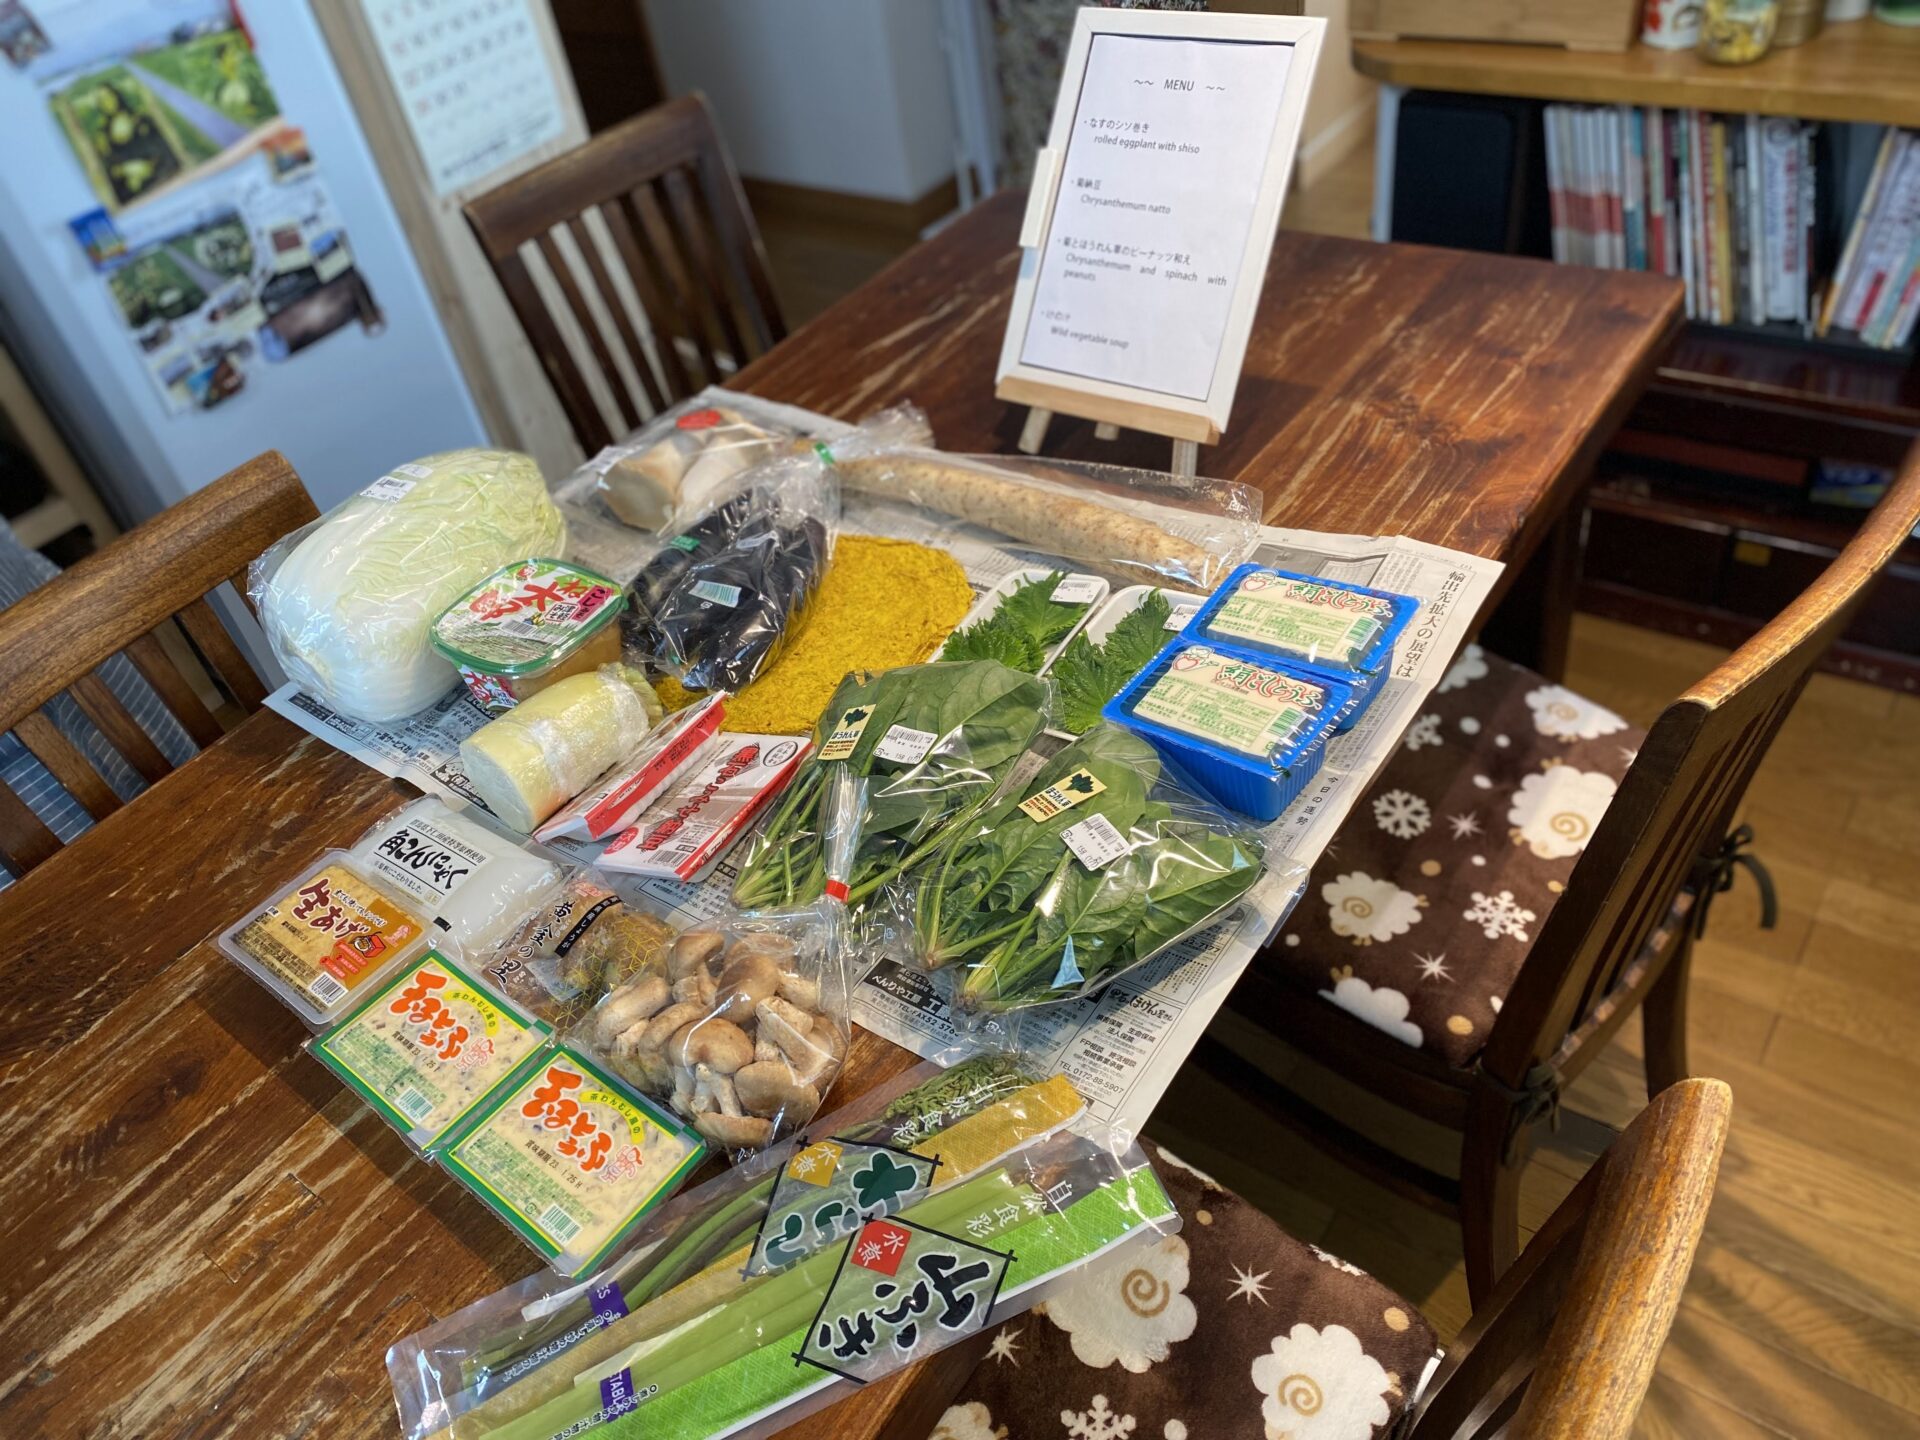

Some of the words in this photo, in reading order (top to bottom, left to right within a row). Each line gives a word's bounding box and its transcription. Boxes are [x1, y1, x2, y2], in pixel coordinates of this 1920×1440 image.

[1164, 78, 1195, 92] MENU
[1094, 134, 1118, 146] rolled
[1119, 137, 1157, 150] eggplant
[1158, 141, 1177, 152] with
[1178, 144, 1200, 154] shiso
[1080, 194, 1146, 212] Chrysanthemum
[1148, 203, 1171, 215] natto
[1063, 268, 1097, 282] peanuts
[1065, 252, 1131, 271] Chrysanthemum
[1139, 265, 1157, 276] and
[1165, 268, 1198, 283] spinach
[1207, 275, 1227, 287] with
[1051, 326, 1069, 338] Wild
[1070, 328, 1108, 345] vegetable
[1109, 338, 1130, 350] soup
[1287, 581, 1393, 618] 絹ごしとうふ
[1216, 663, 1323, 711] 絹ごしとうふ
[378, 828, 470, 890] 角こんにゃく
[292, 878, 371, 939] 生あげ
[1059, 1060, 1073, 1072] TEL
[1073, 1067, 1125, 1094] 0172-88-5907
[795, 1145, 837, 1180] 水煮
[966, 1179, 1074, 1240] 自然食彩
[857, 1230, 906, 1268] 水煮
